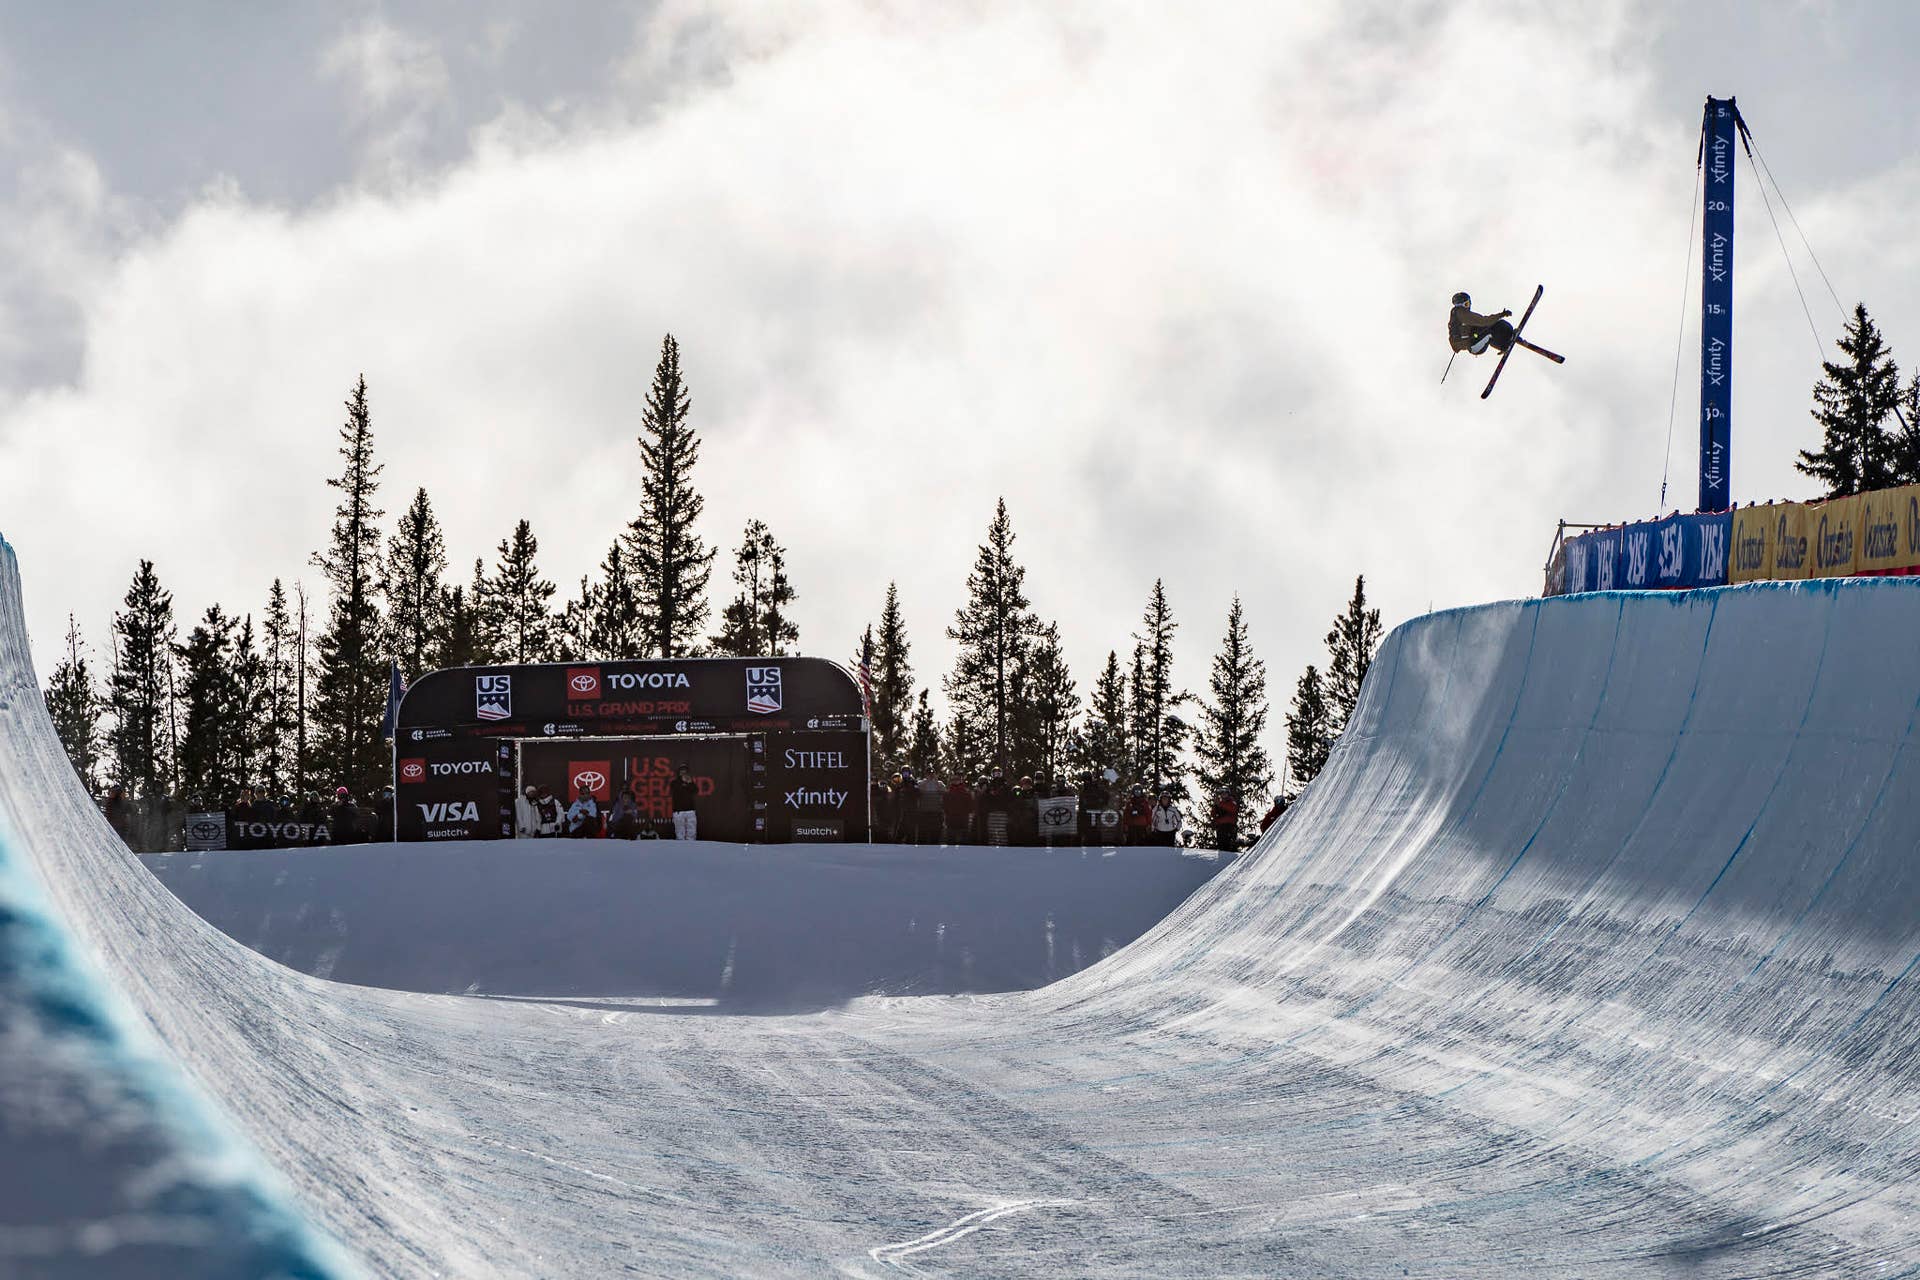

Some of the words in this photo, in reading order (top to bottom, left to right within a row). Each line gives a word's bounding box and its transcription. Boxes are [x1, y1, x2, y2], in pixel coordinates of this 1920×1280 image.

[1710, 134, 1730, 184] xfinity
[1708, 232, 1728, 282] xfinity
[1706, 336, 1726, 386] xfinity
[1699, 523, 1724, 580] VISA
[478, 677, 509, 692] US
[607, 673, 691, 690] TOYOTA
[747, 668, 780, 685] US
[567, 703, 594, 717] U.S.
[599, 702, 654, 716] GRAND
[658, 701, 691, 714] PRIX
[430, 760, 492, 775] TOYOTA
[631, 756, 675, 777] U.S.
[784, 786, 849, 809] xfinity
[416, 799, 480, 823] VISA
[234, 820, 332, 841] TOYOTA
